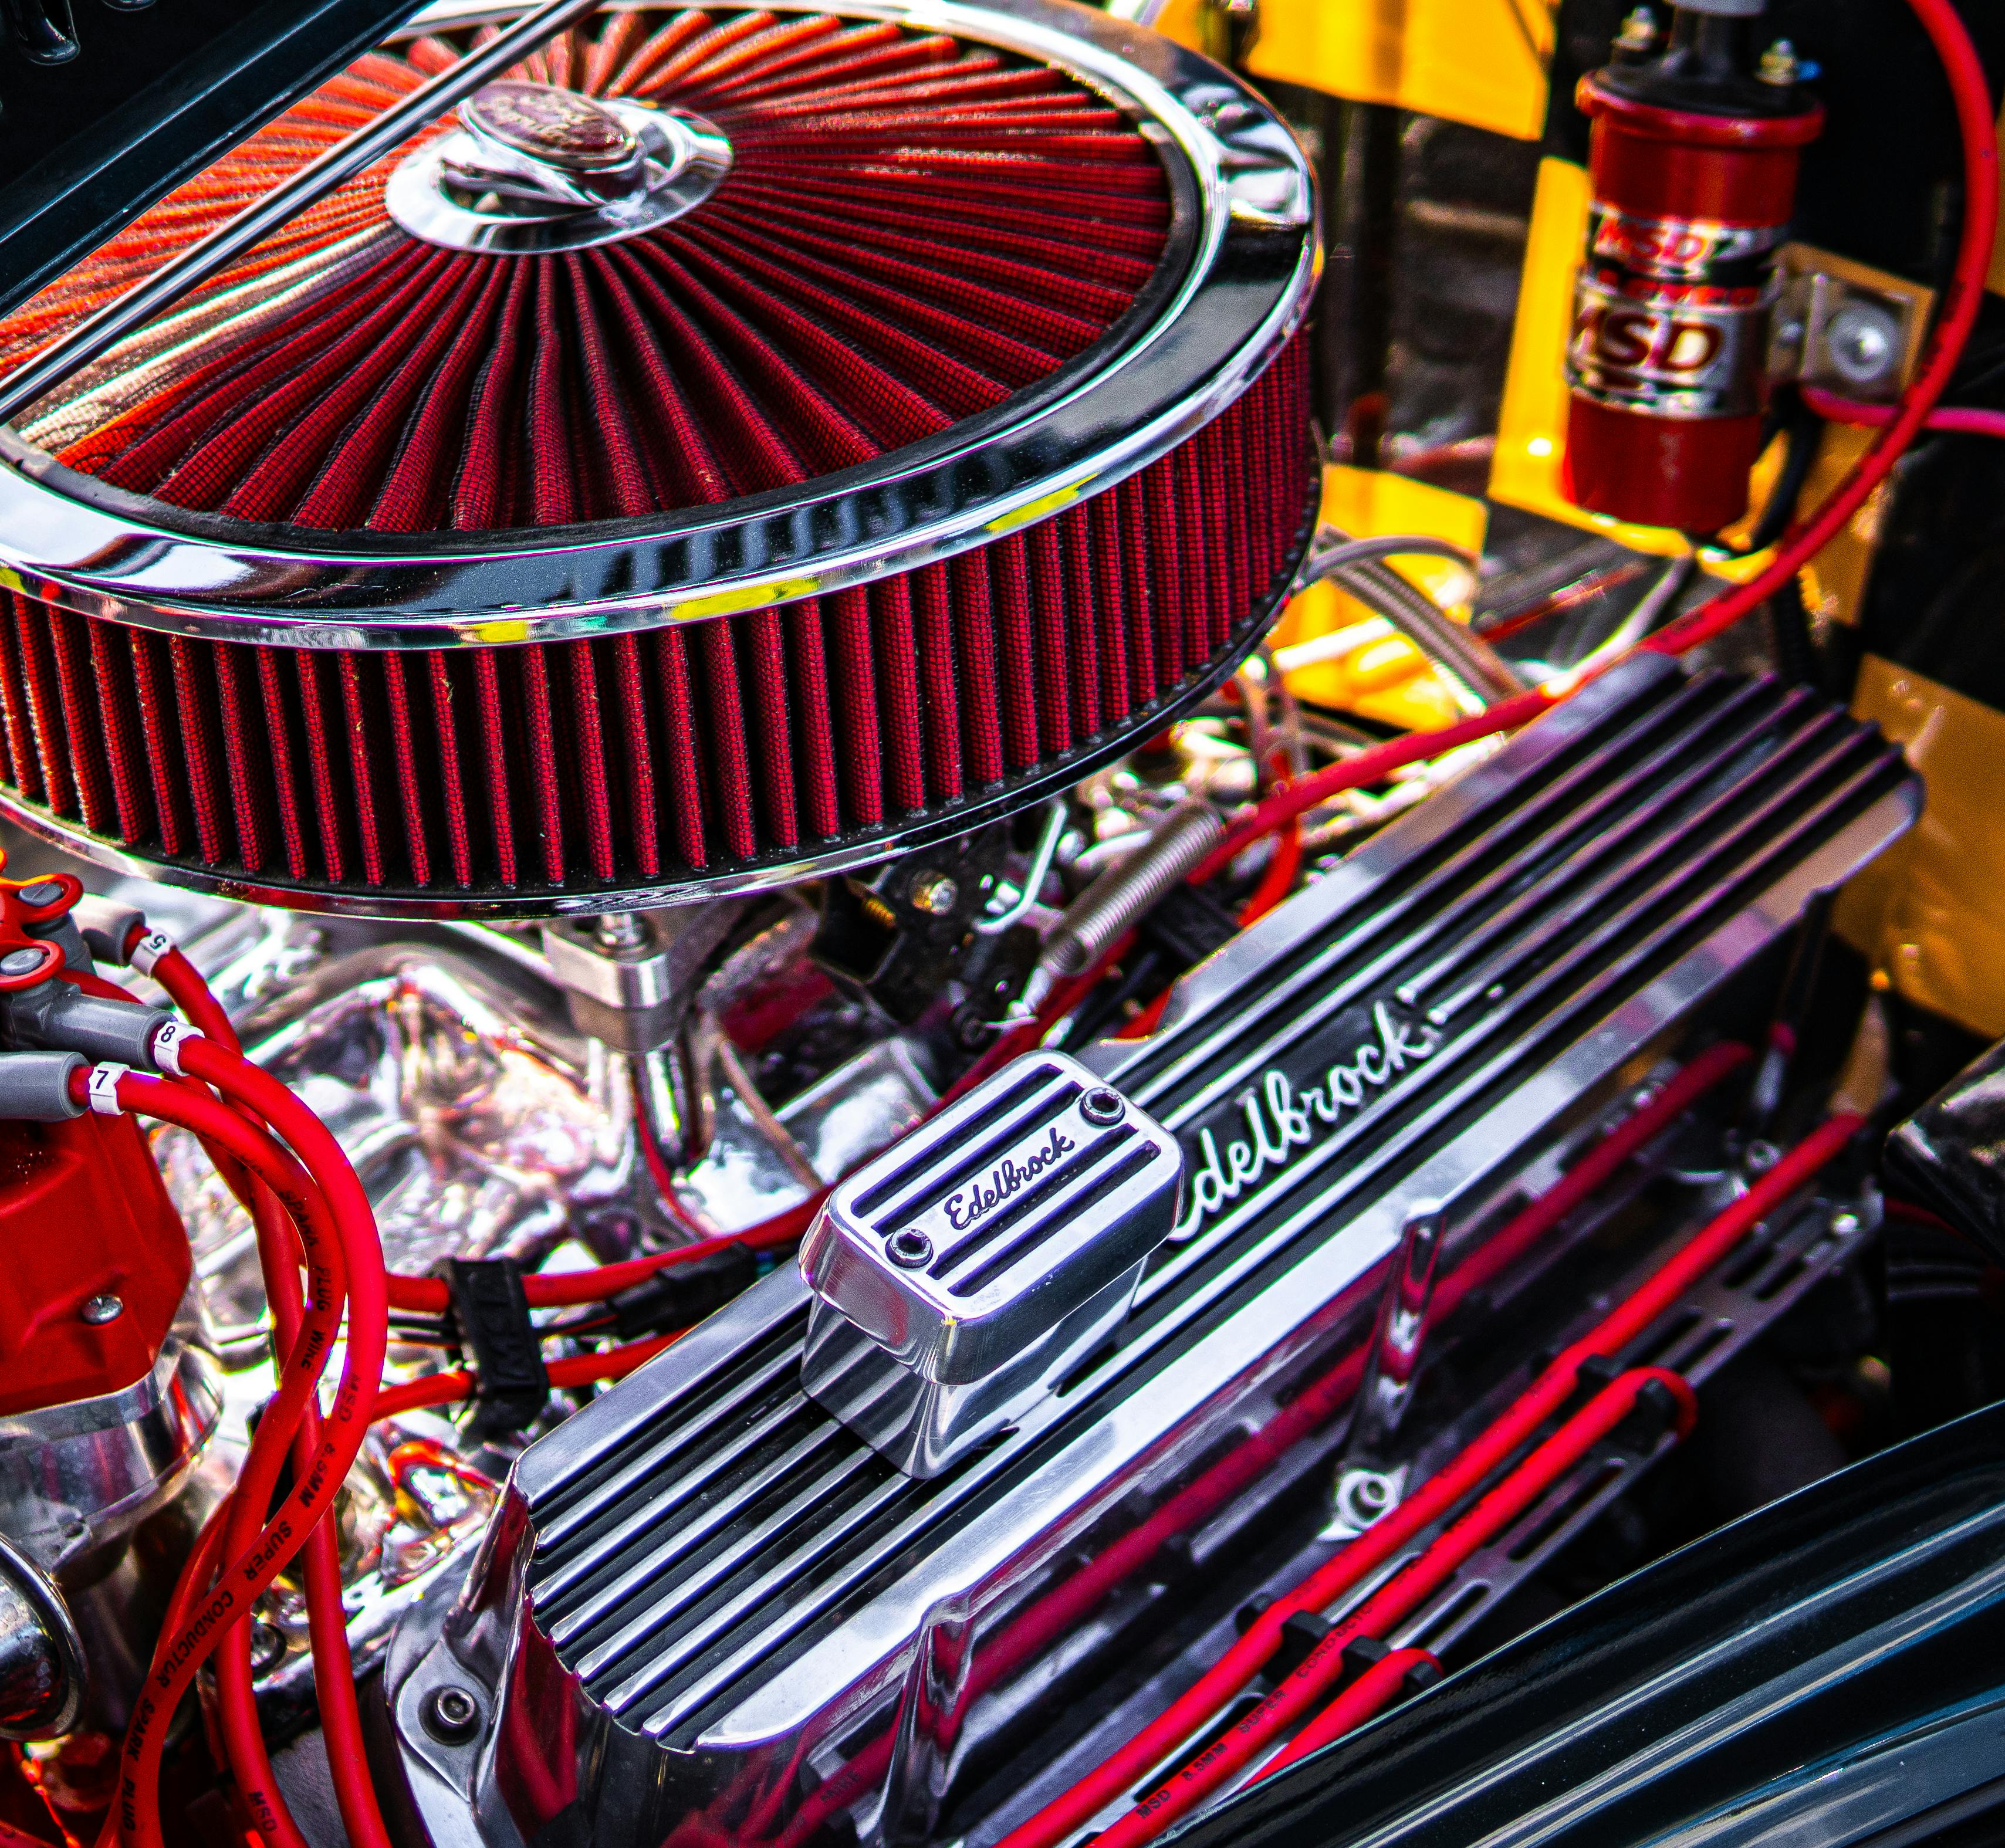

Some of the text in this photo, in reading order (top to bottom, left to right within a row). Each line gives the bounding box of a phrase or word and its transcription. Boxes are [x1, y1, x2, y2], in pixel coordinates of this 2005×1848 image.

[150, 933, 167, 950] 5
[160, 1025, 176, 1043] 8
[95, 1069, 109, 1089] 7
[1167, 1000, 1442, 1241] delbrock
[944, 1127, 1076, 1230] Edelbrock
[244, 1520, 292, 1581] SUPER
[126, 1698, 155, 1762] SPARK
[1135, 1788, 1171, 1819] MSD
[1237, 1690, 1287, 1734] SUPER
[1294, 1603, 1374, 1679] CONDUCTO
[121, 1776, 136, 1832] PLUG
[249, 1791, 278, 1832] MSD
